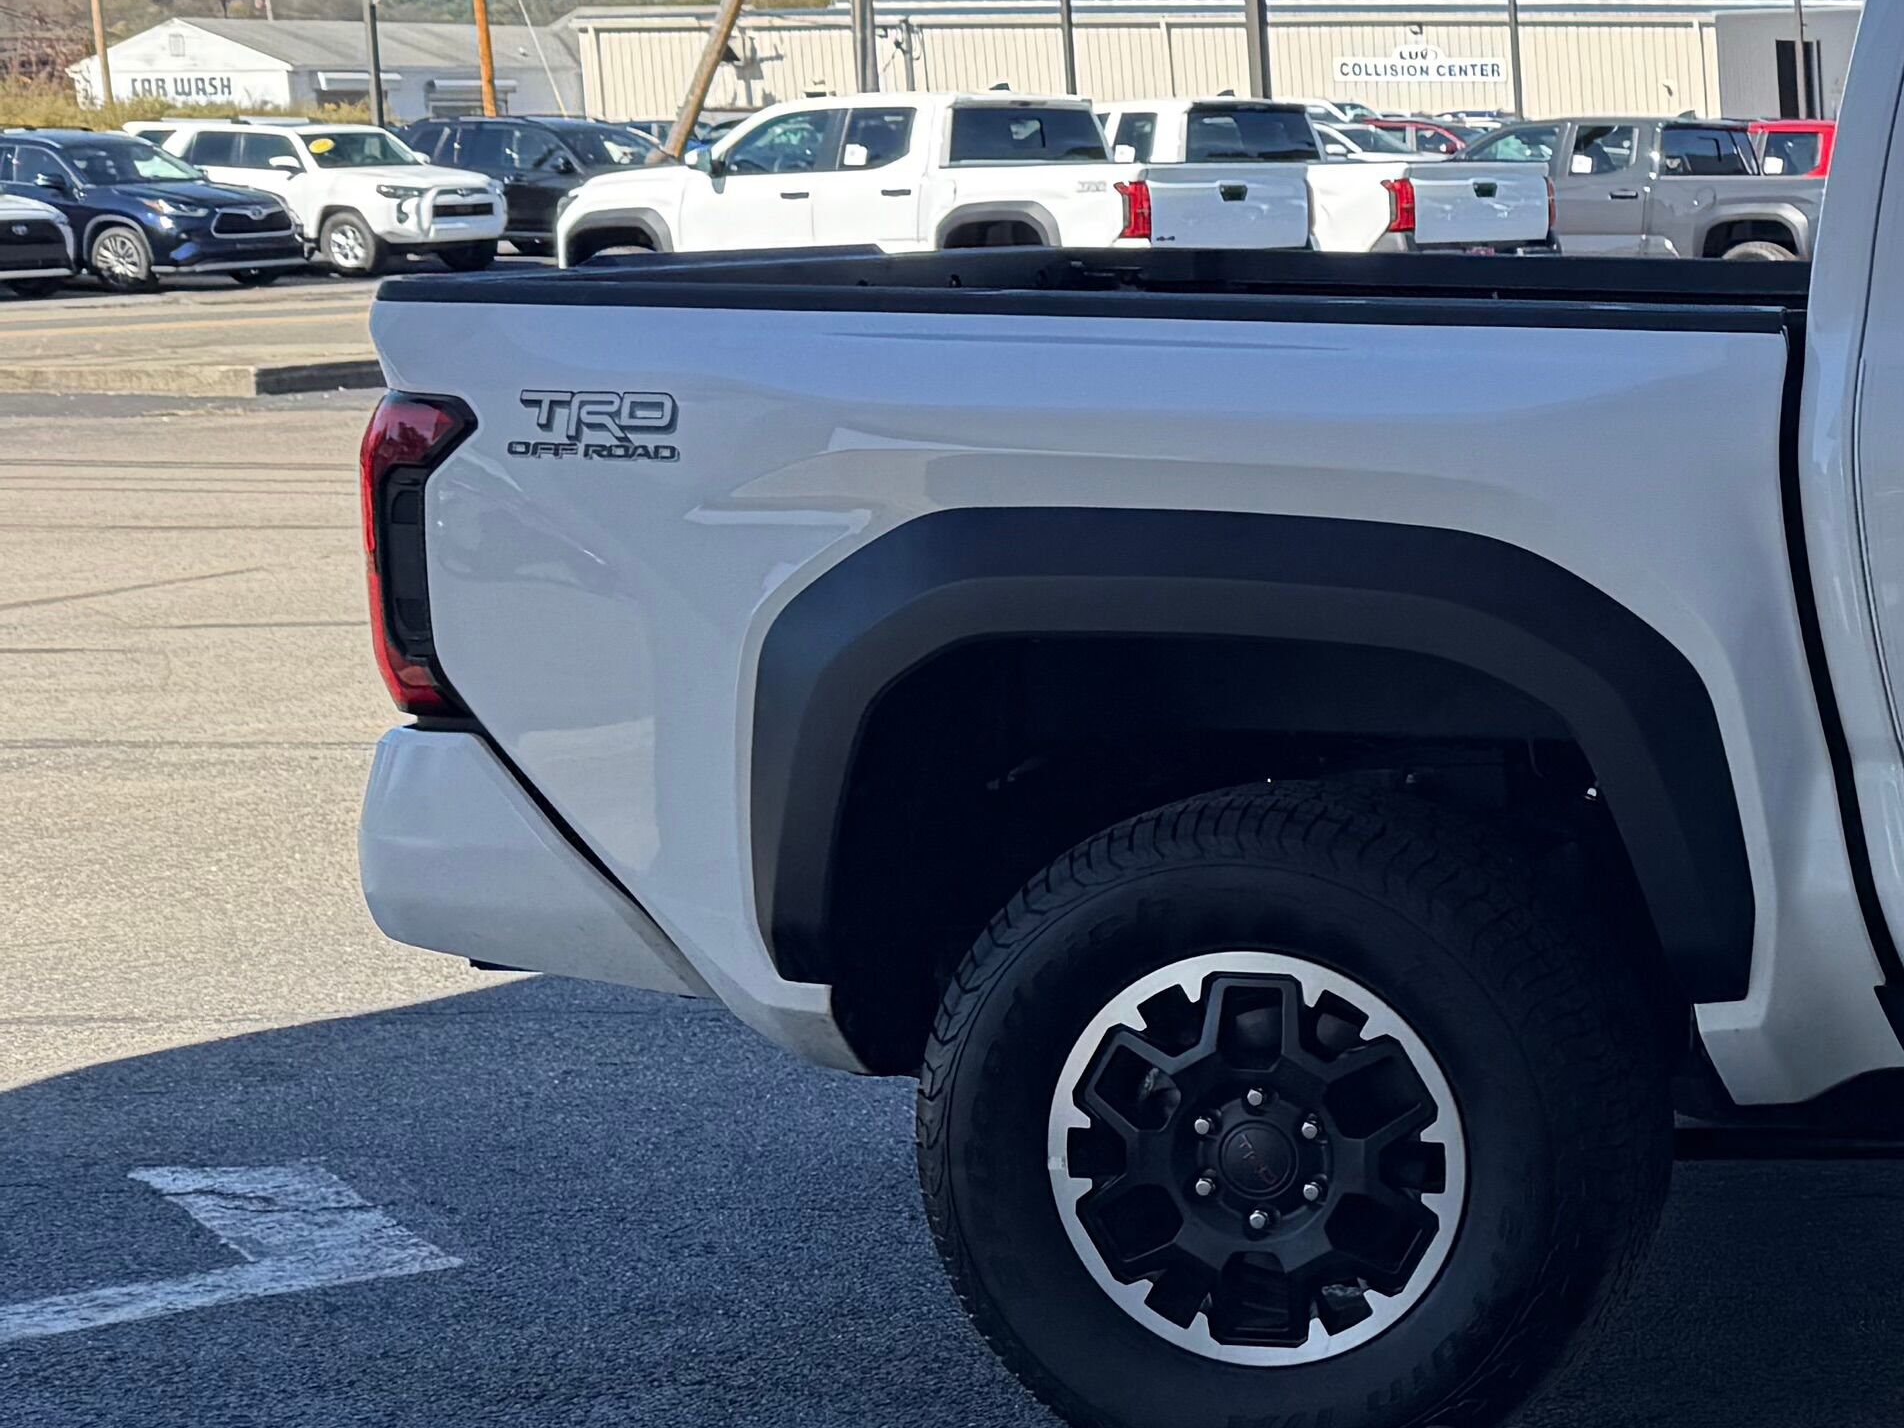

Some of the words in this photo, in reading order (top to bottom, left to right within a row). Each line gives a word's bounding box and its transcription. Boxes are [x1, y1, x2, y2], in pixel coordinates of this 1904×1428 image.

[1340, 63, 1429, 77] COLLISION
[1436, 64, 1501, 77] CENTER
[130, 78, 168, 97] CAR
[173, 76, 232, 97] WASH
[520, 389, 679, 445] TRD
[507, 441, 578, 459] OFF
[583, 443, 681, 462] ROAD
